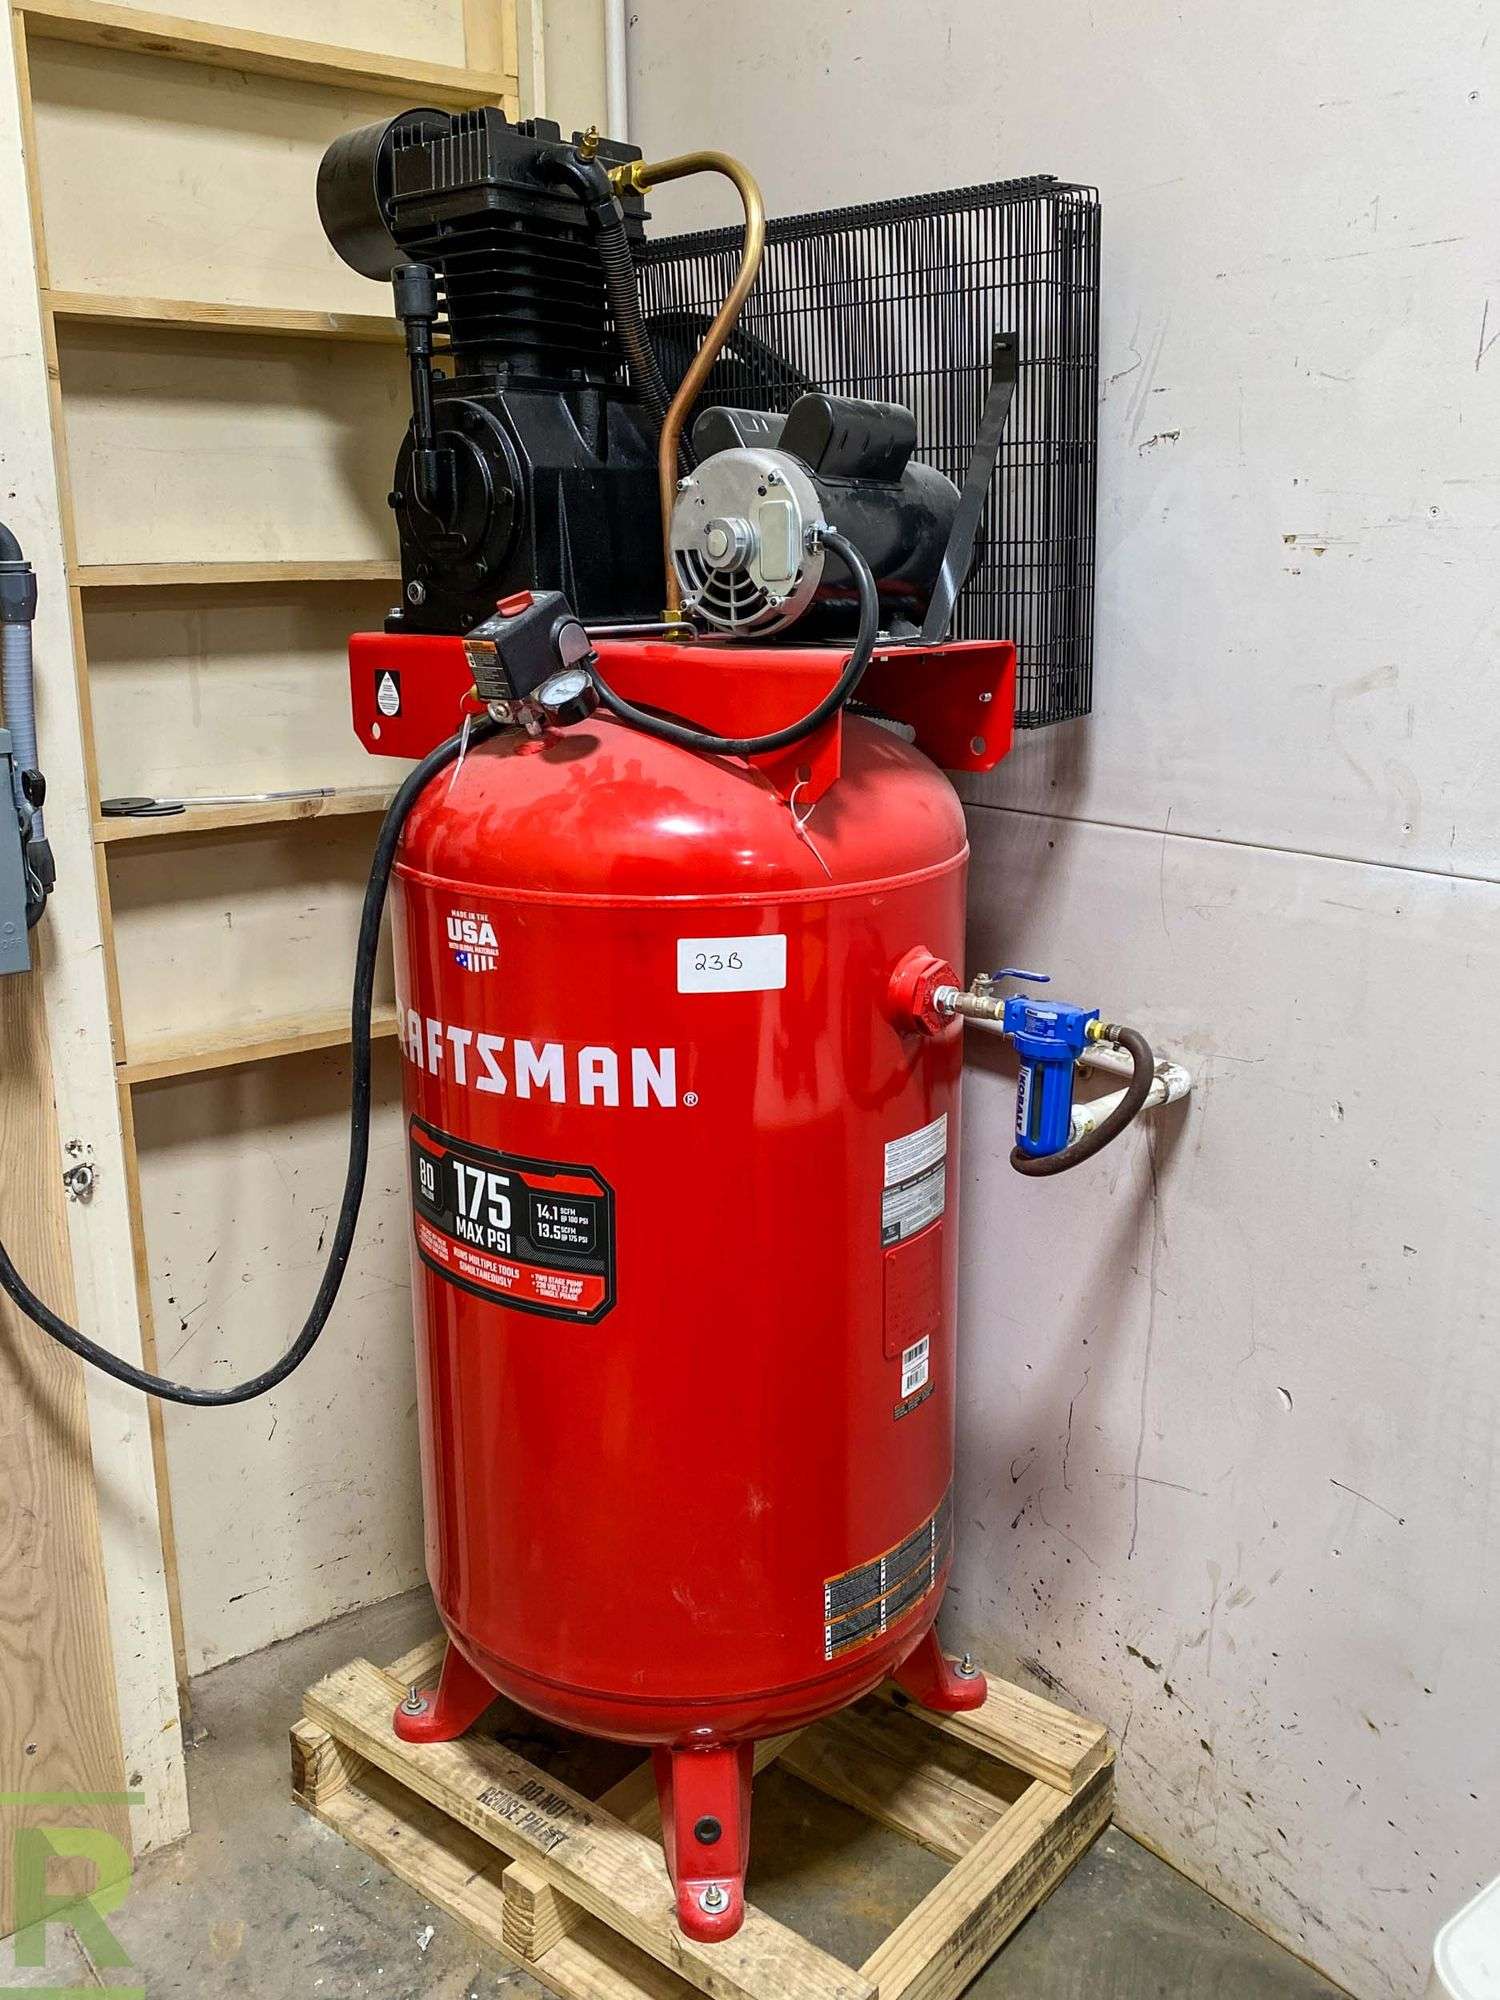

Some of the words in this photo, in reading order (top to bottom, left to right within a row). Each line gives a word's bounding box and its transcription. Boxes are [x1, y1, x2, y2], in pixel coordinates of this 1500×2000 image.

[451, 909, 467, 919] MADE
[468, 912, 476, 920] IN
[476, 913, 489, 922] THE
[446, 916, 498, 947] USA
[694, 951, 743, 971] 23B
[419, 1157, 434, 1191] 80
[453, 1160, 511, 1229] 175
[536, 1203, 558, 1221] 14.1
[560, 1207, 576, 1215] SCFM
[579, 1217, 589, 1225] PSI
[456, 1215, 485, 1246] MAX
[487, 1227, 511, 1254] PSI
[537, 1222, 561, 1240] 13.5
[561, 1226, 577, 1234] SCFM
[569, 1234, 578, 1242] 175
[578, 1235, 588, 1244] PSI
[459, 1260, 513, 1289] SIMULTANEOUSLY
[468, 1252, 498, 1273] MULTIPLE
[498, 1264, 520, 1279] TOOLS
[516, 1778, 546, 1802] DO
[537, 1792, 575, 1819] NOT
[476, 1785, 528, 1821] REUSE
[515, 1811, 570, 1847] PALT
